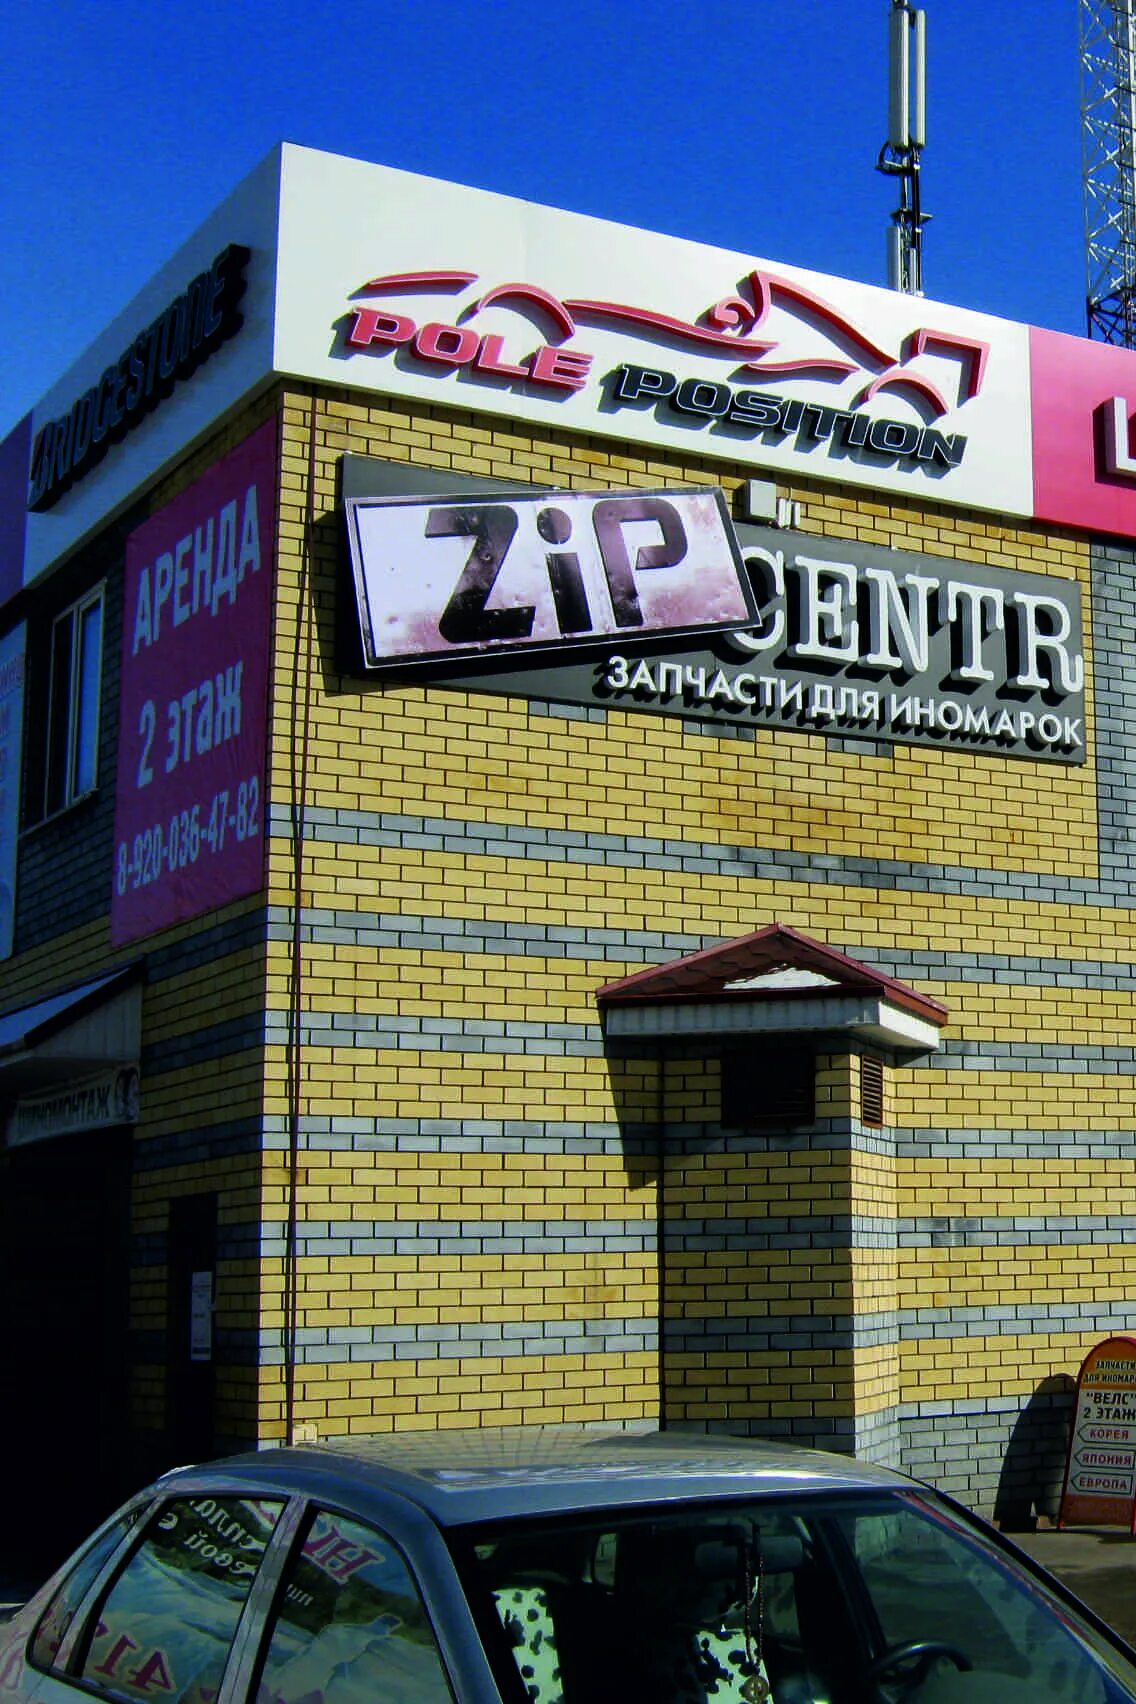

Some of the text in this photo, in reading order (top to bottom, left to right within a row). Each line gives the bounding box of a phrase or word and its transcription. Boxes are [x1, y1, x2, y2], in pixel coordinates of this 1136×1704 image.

[28, 244, 246, 510] BRIDGESTONE
[348, 306, 968, 467] POLE POSITION
[132, 484, 261, 656] АРЕНДА
[728, 546, 1084, 694] CENTR
[136, 699, 156, 789] 2
[607, 655, 1083, 746] ЗАПЧАСТИ ДЛЯ ИНОМАРОК
[1095, 1359, 1136, 1370] ЗАПЧАСТИ
[1082, 1453, 1132, 1465] ЯПОНИЯ
[1083, 1407, 1136, 1421] 2 ЭТАЖ
[1089, 1429, 1130, 1441] КОРЕЯ
[1079, 1477, 1128, 1490] ЕВРОПА
